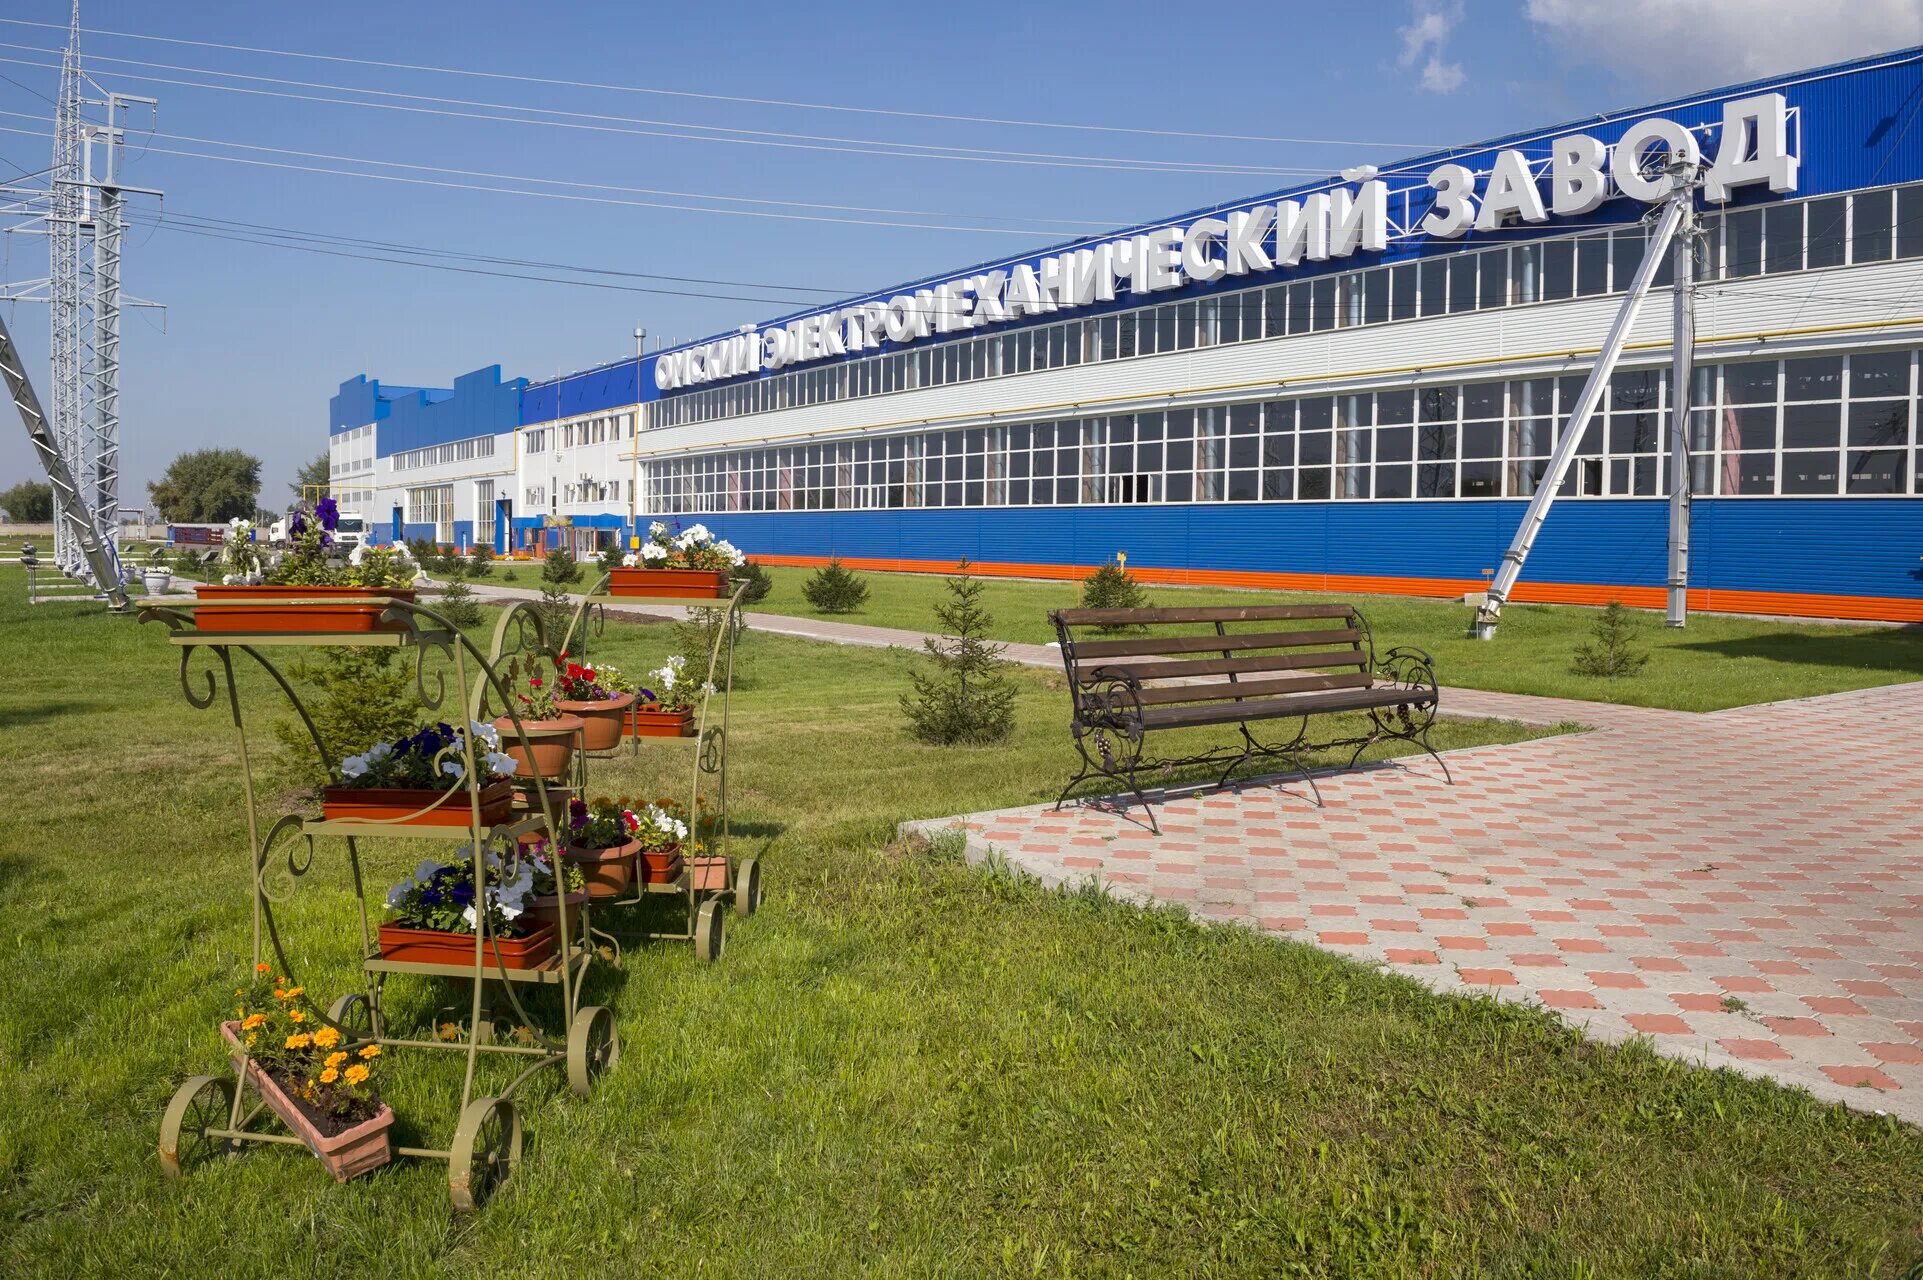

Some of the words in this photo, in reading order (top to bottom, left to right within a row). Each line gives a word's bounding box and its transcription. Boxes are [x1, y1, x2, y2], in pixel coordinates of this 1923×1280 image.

[655, 324, 759, 390] ОМСКИЙ
[763, 165, 1387, 369] ЭЛЕКТРОМЕХАНИЧЕСКИЙ
[1422, 93, 1797, 238] ЗАВОД
